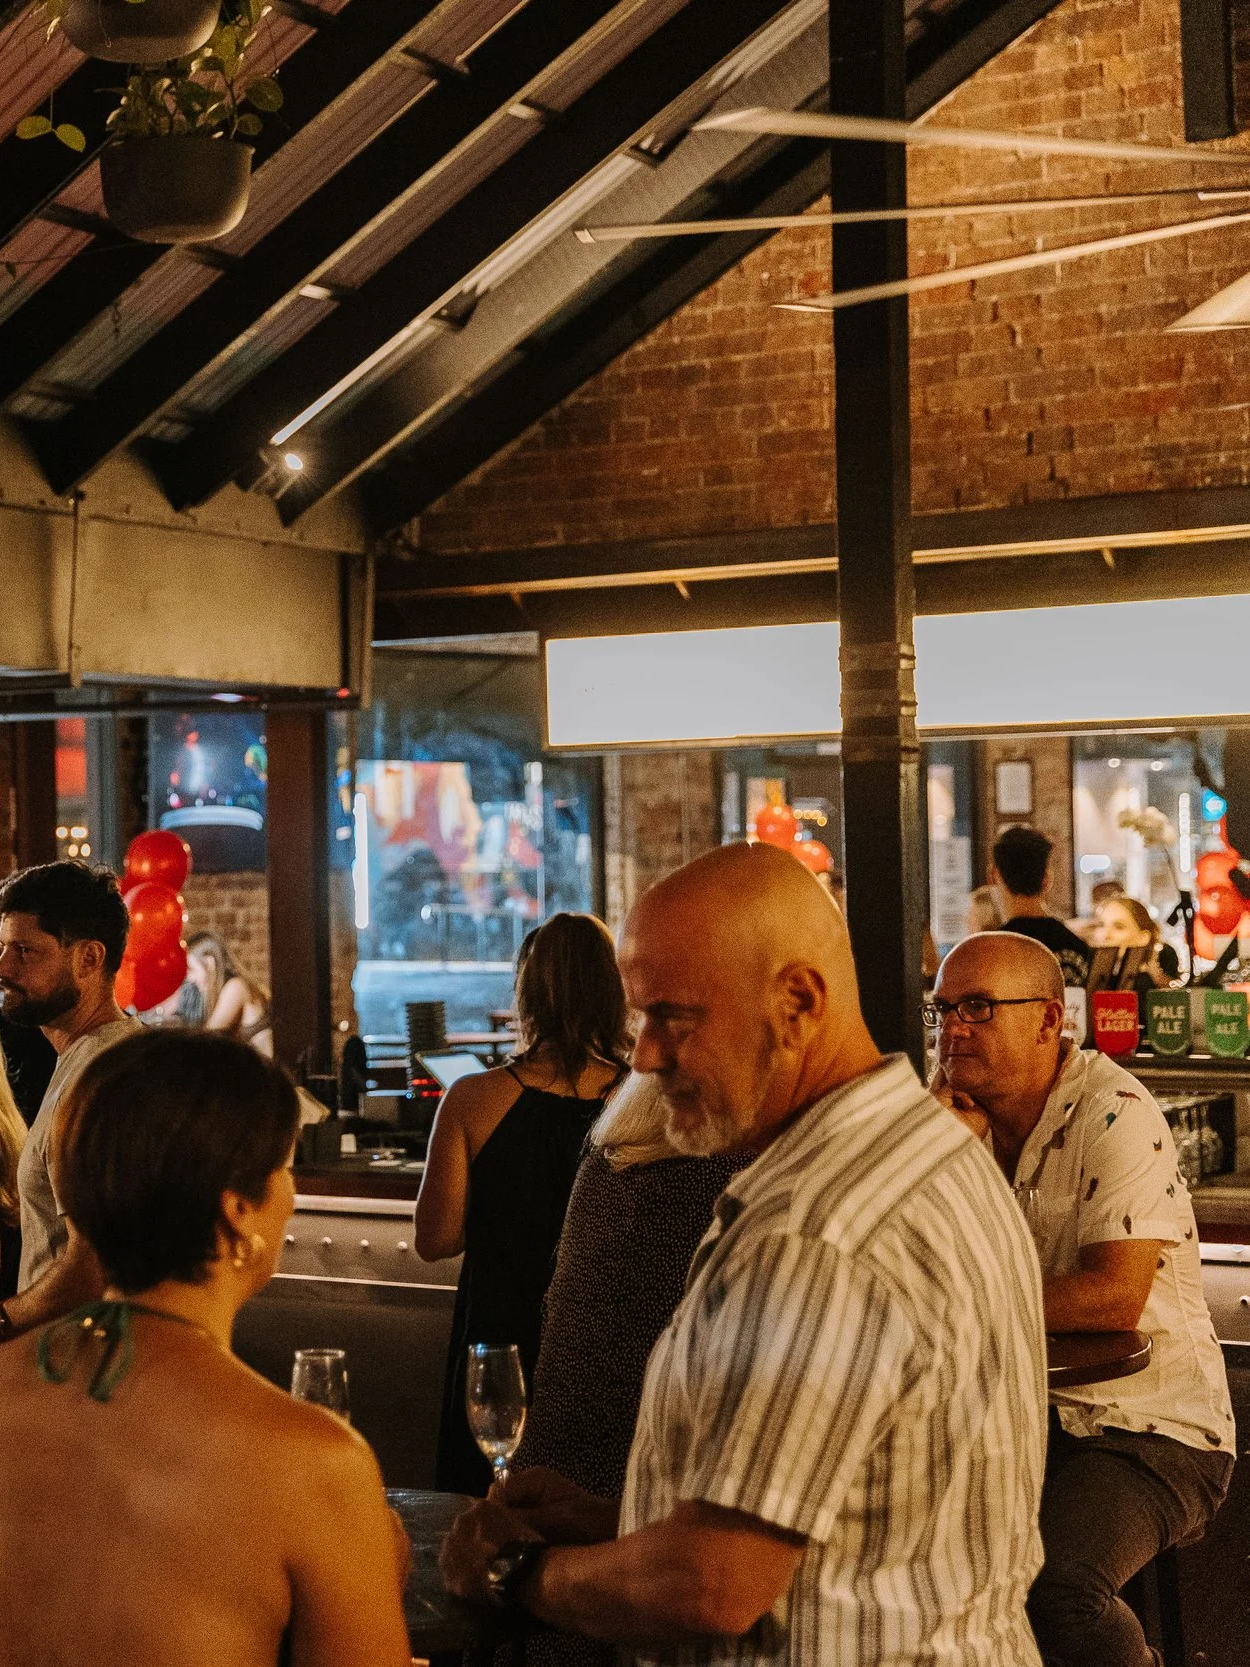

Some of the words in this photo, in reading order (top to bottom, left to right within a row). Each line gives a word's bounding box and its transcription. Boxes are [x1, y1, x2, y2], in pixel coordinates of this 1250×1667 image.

[1152, 1005, 1186, 1019] PALE
[1210, 1003, 1242, 1017] PALE
[1156, 1021, 1183, 1035] ALE
[1215, 1022, 1239, 1035] ALE
